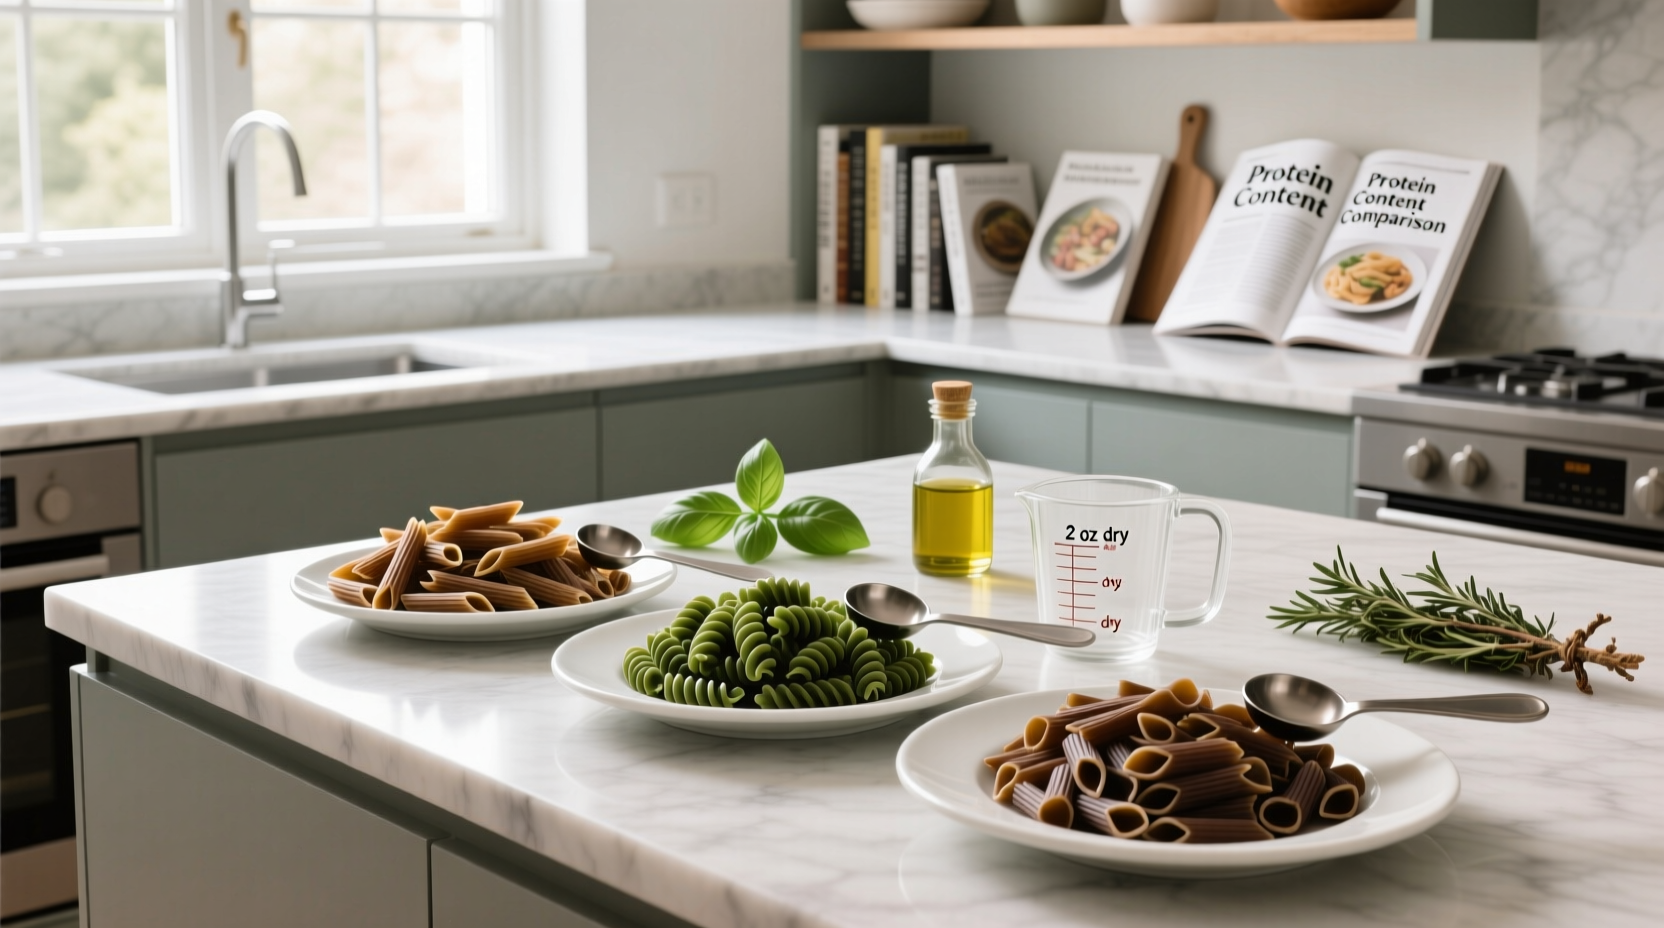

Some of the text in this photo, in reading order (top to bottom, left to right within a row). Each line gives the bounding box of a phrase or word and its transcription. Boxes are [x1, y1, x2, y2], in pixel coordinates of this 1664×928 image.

[1247, 164, 1334, 195] Protein
[1367, 172, 1436, 195] Protein
[1233, 187, 1328, 219] Content
[1353, 190, 1426, 211] Content
[1340, 209, 1446, 234] Comparison
[1065, 525, 1129, 546] 2 oz dry
